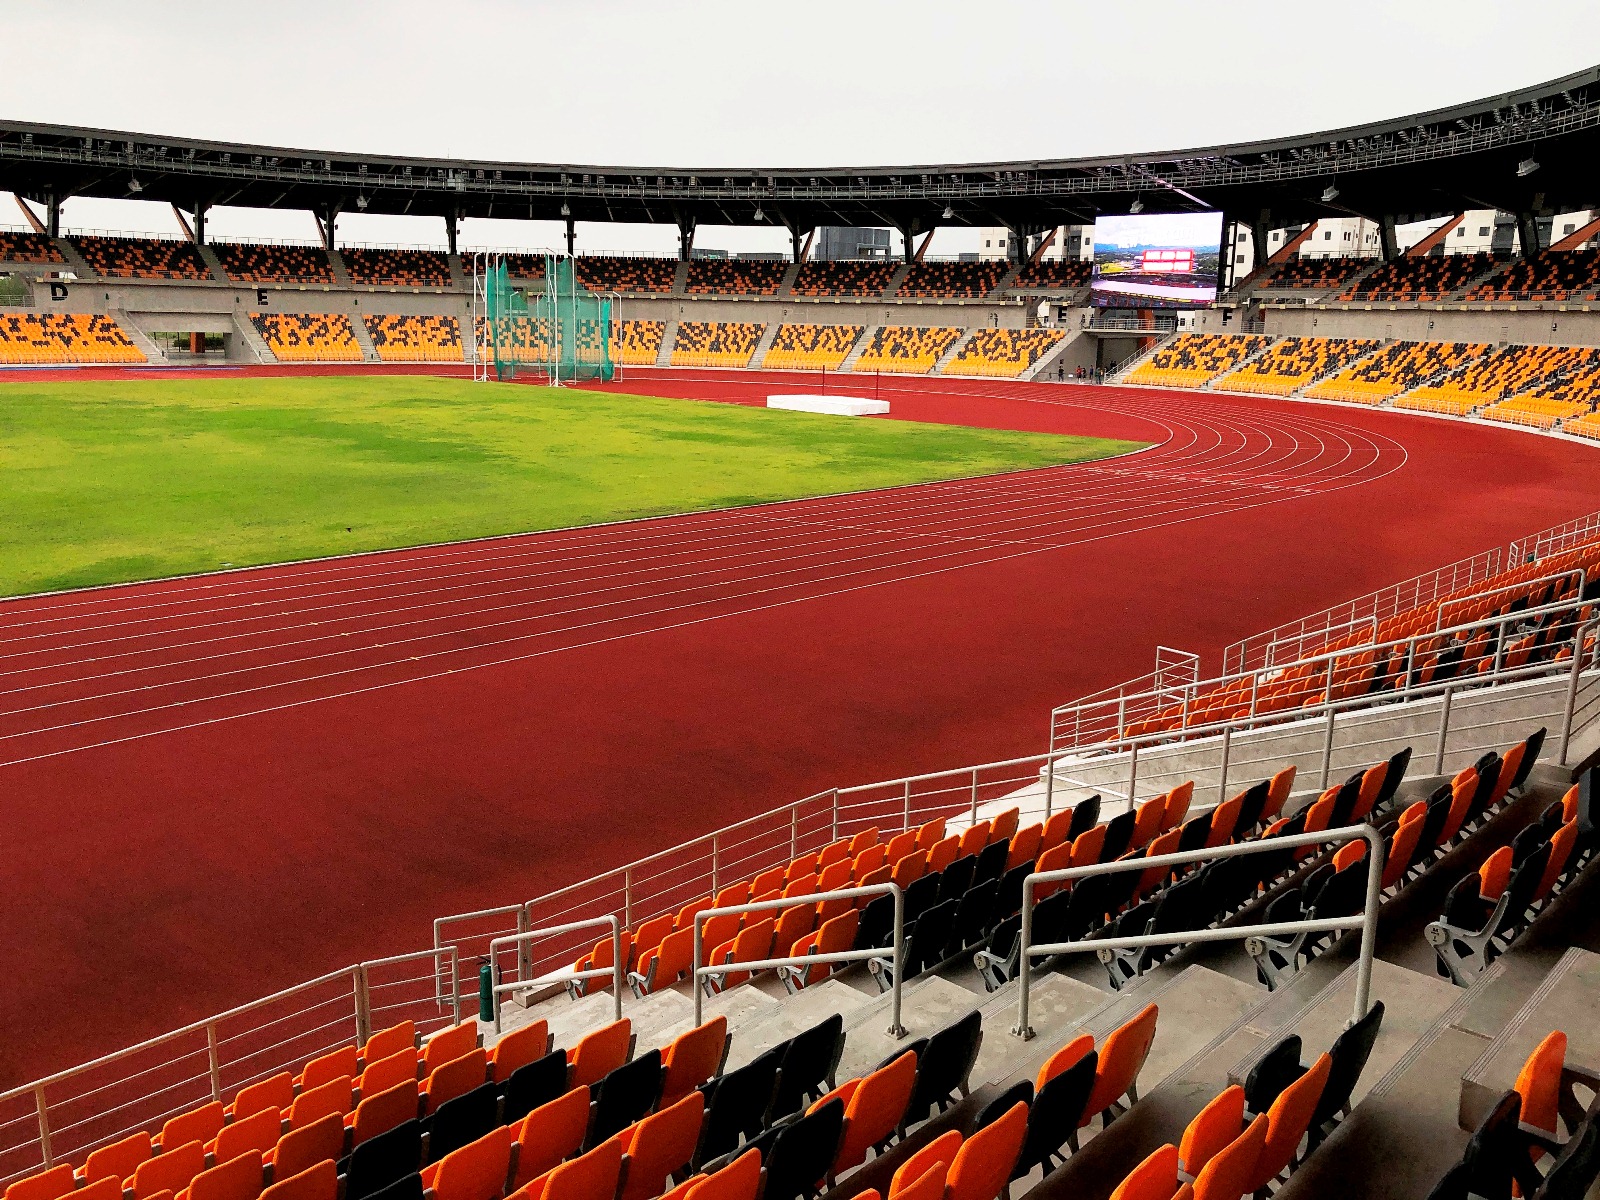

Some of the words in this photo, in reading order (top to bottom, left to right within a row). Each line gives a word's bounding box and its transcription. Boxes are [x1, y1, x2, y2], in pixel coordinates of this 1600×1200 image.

[51, 282, 68, 301] D
[257, 289, 268, 305] E
[1222, 308, 1232, 326] F
